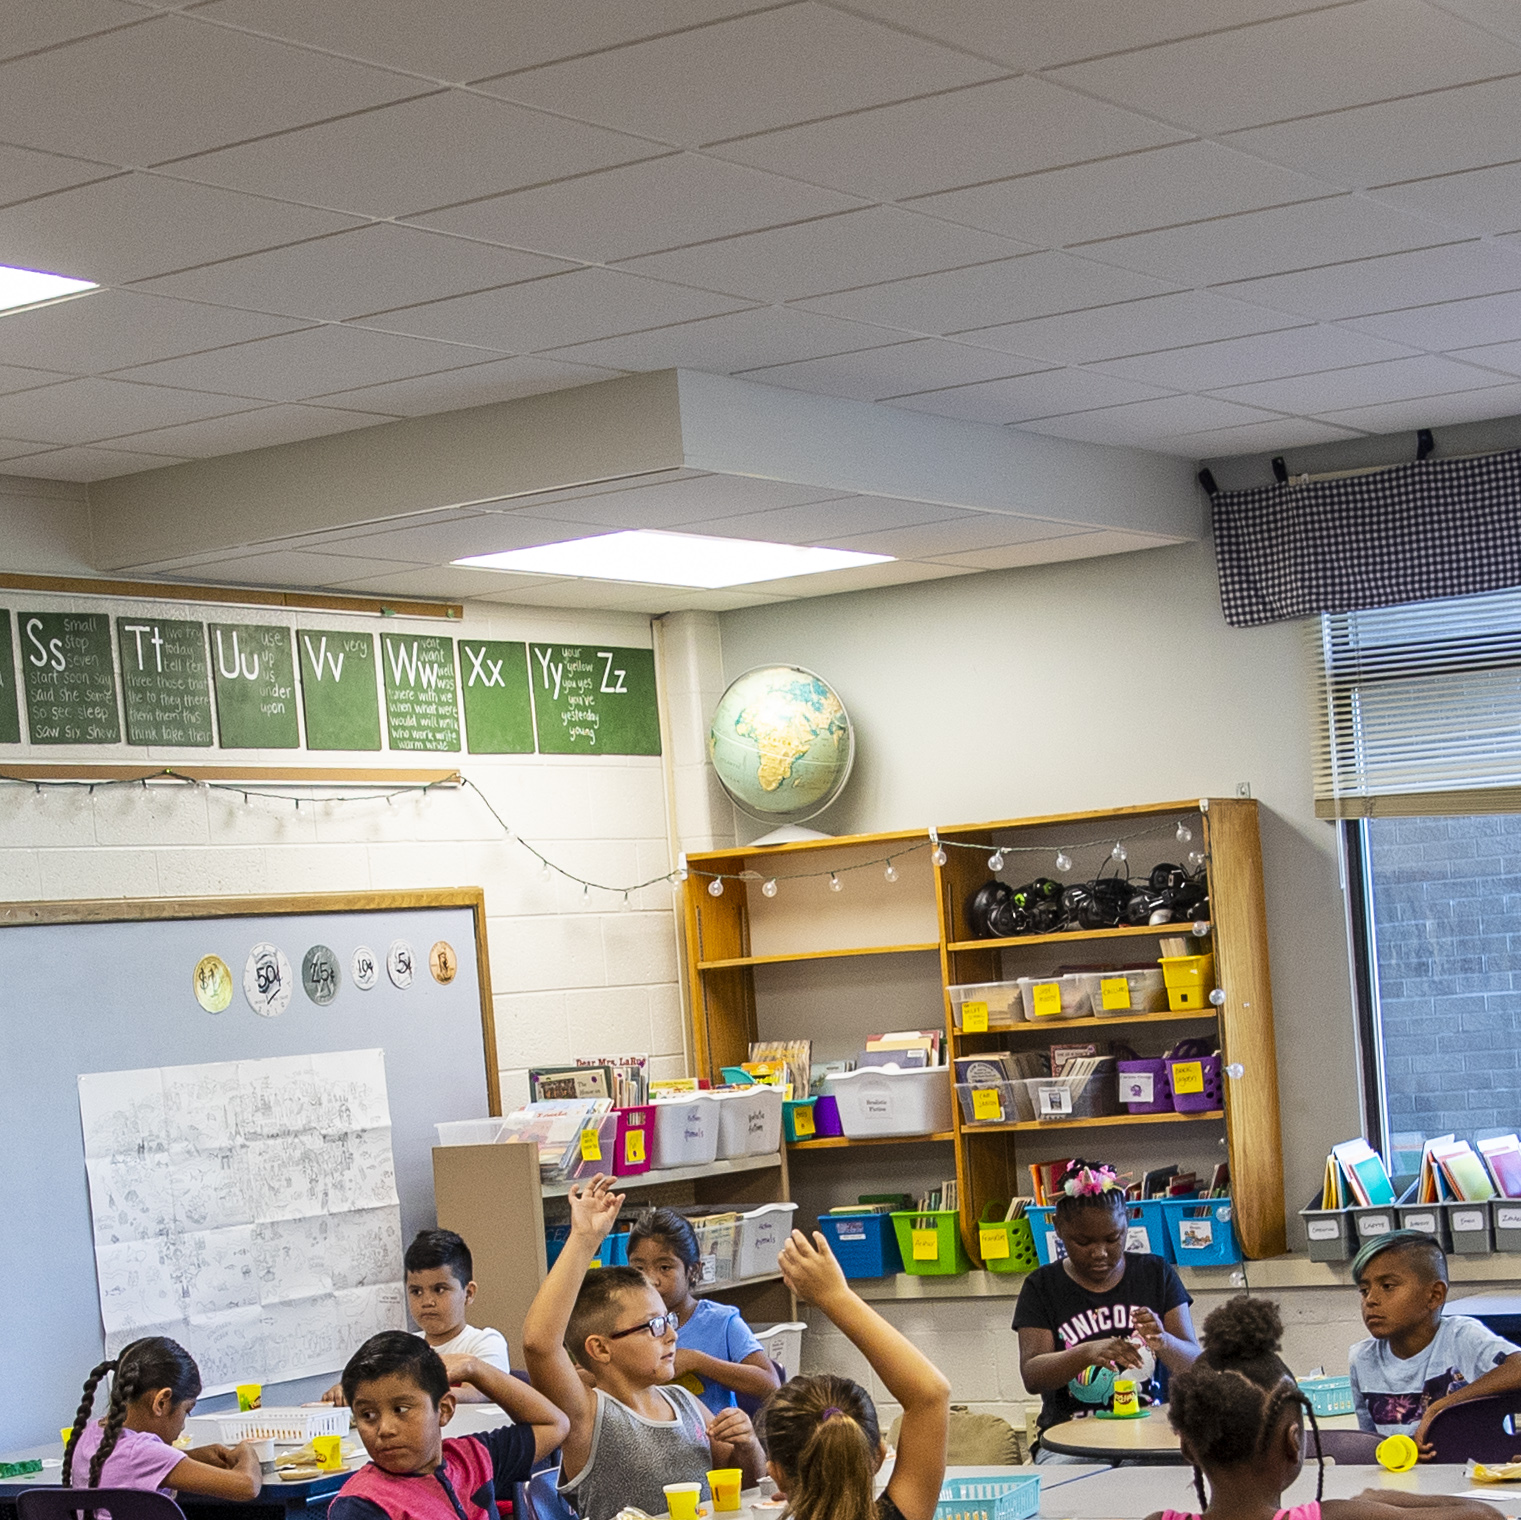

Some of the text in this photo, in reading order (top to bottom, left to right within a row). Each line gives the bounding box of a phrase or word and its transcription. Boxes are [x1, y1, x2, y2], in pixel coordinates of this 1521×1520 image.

[26, 618, 66, 672] Ss
[262, 632, 283, 646] use
[125, 625, 163, 673] Tt
[216, 630, 260, 680] Uu
[343, 640, 367, 658] very
[262, 650, 275, 667] up
[304, 635, 344, 682] Vv
[386, 638, 438, 690] Ww
[464, 646, 506, 687] Xx
[263, 670, 276, 682] us
[534, 647, 563, 700] Yy
[565, 661, 593, 678] yellow
[597, 652, 628, 693] Zz
[260, 683, 291, 699] under
[562, 678, 593, 694] you yes
[418, 688, 453, 703] with we
[260, 702, 285, 717] upon
[421, 715, 438, 728] will
[560, 710, 600, 729] yesterday
[569, 727, 596, 746] young
